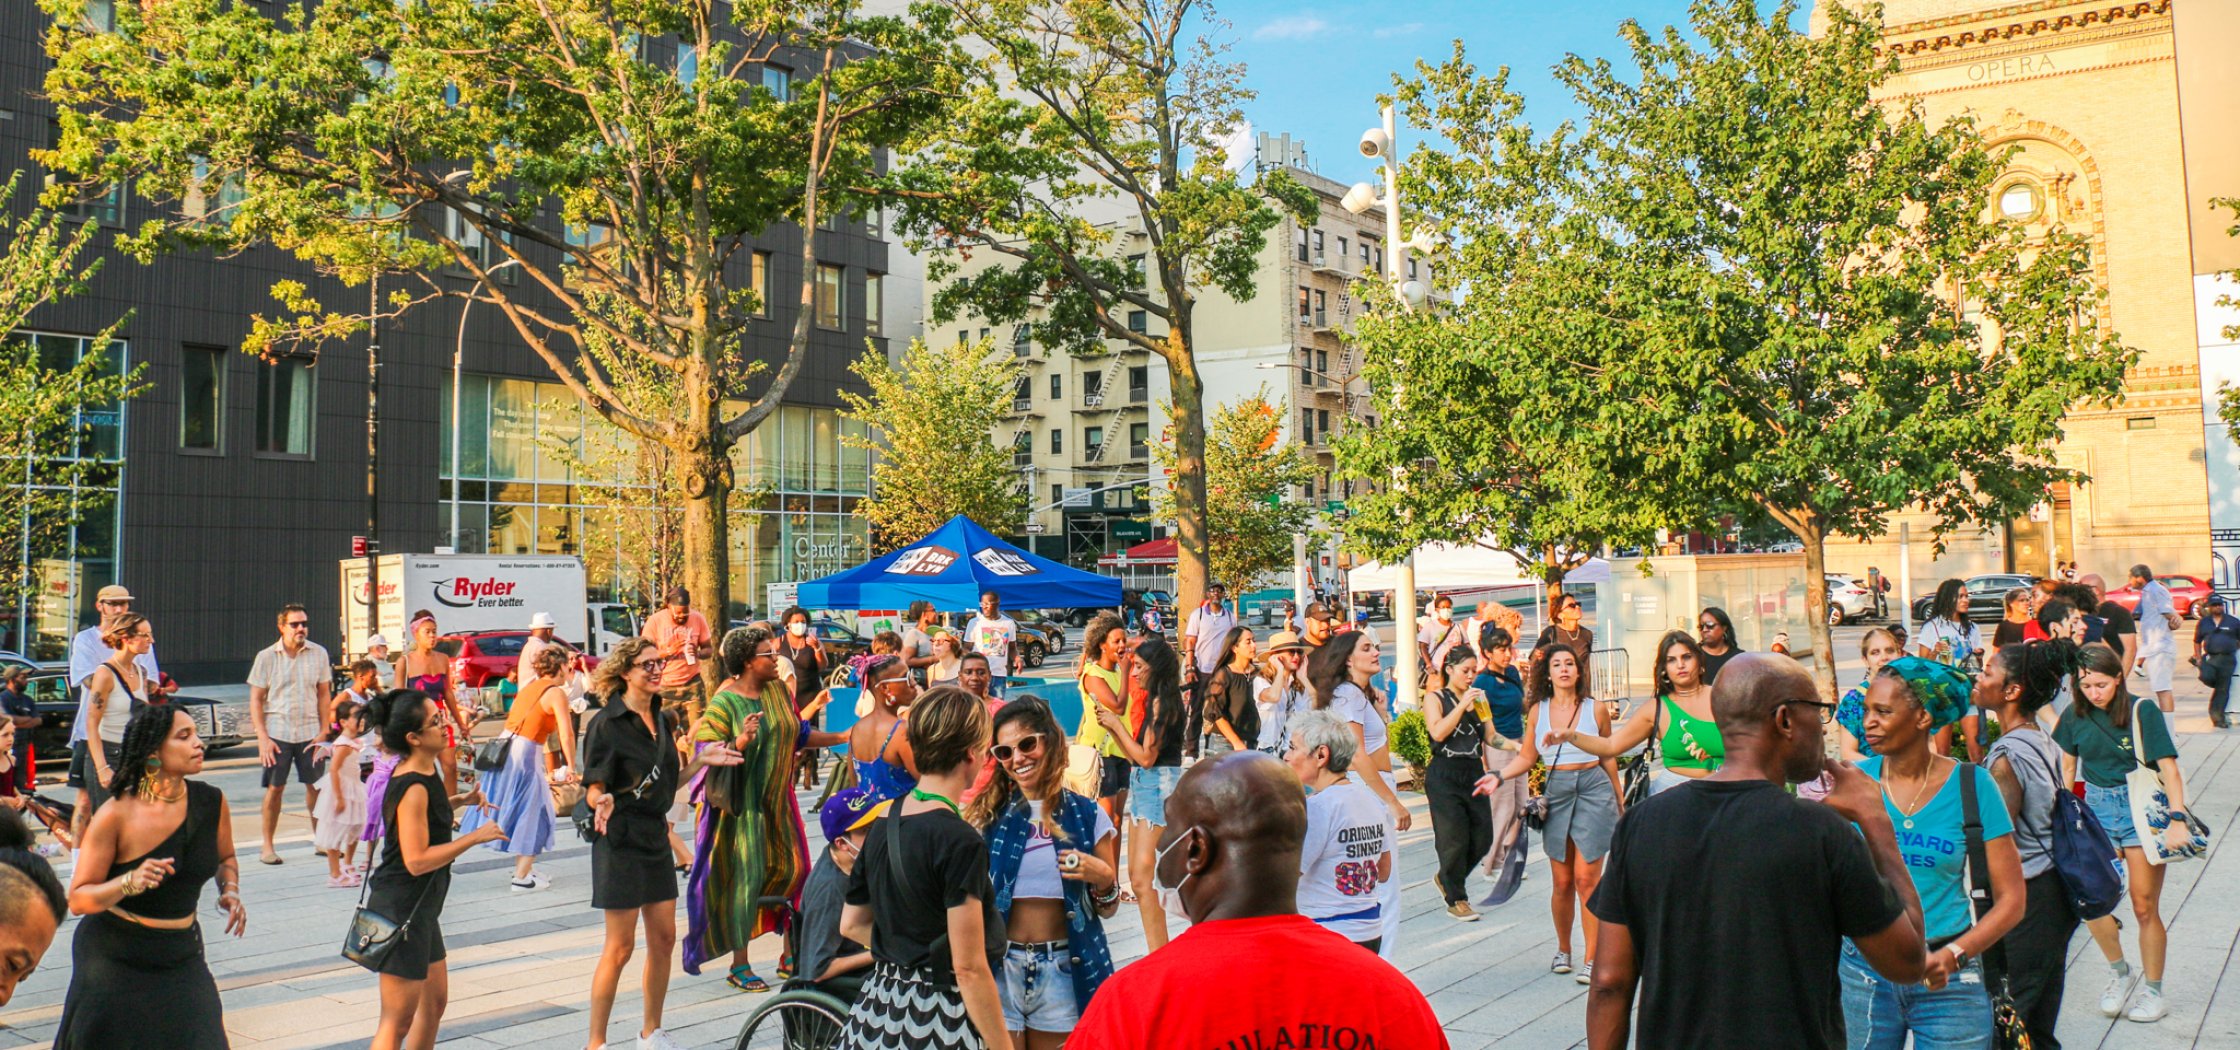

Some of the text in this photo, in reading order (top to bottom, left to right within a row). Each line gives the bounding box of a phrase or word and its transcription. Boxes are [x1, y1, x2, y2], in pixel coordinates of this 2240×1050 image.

[1967, 53, 2056, 81] OPERA
[493, 407, 505, 417] The
[503, 419, 518, 428] That
[492, 429, 505, 438] Fall
[795, 537, 852, 558] Center
[925, 551, 955, 566] BRK
[914, 562, 946, 574] LYN
[363, 580, 398, 597] Rder
[454, 577, 516, 601] Ryder
[478, 597, 524, 607] Ever better.
[1338, 823, 1385, 844] ORIGINAL
